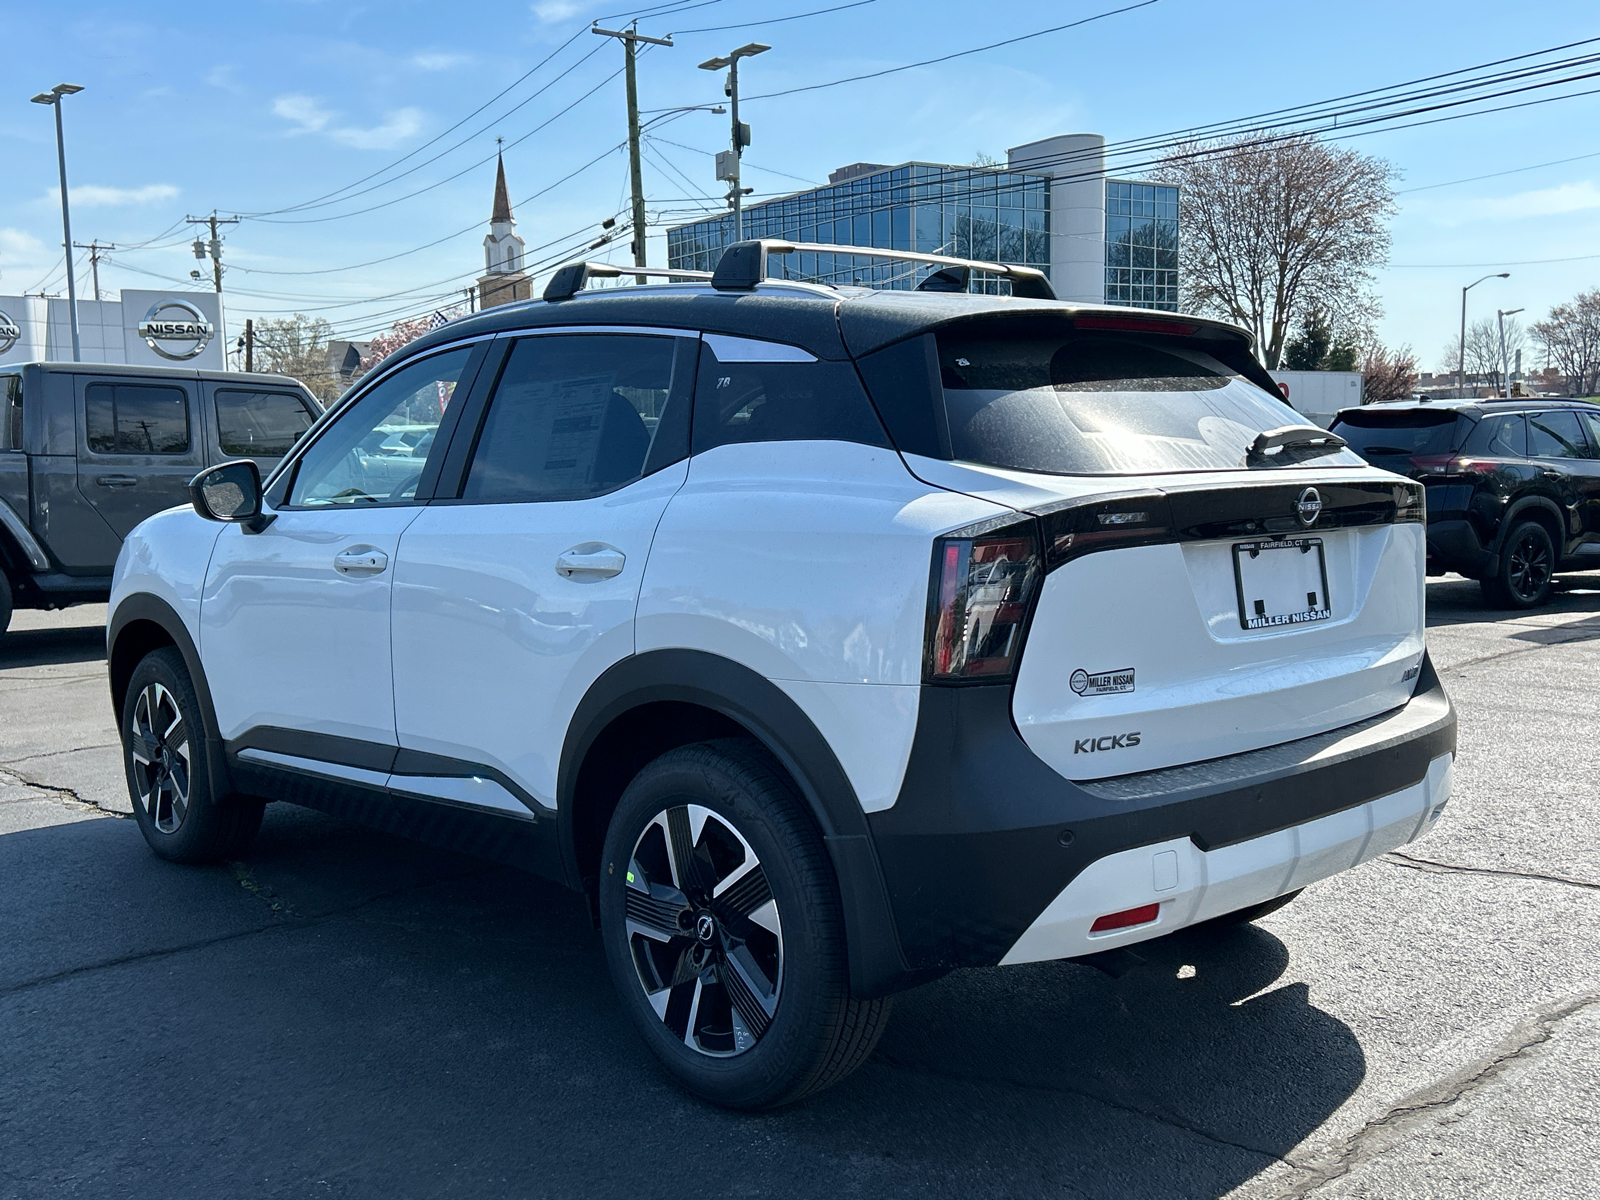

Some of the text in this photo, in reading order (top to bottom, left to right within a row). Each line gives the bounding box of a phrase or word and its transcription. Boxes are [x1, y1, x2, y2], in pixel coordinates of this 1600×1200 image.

[147, 323, 208, 335] NISSAN
[1247, 609, 1331, 629] MILLER NISSAN
[1088, 674, 1134, 688] MILLER NISSAN
[1074, 731, 1141, 754] KICKS
